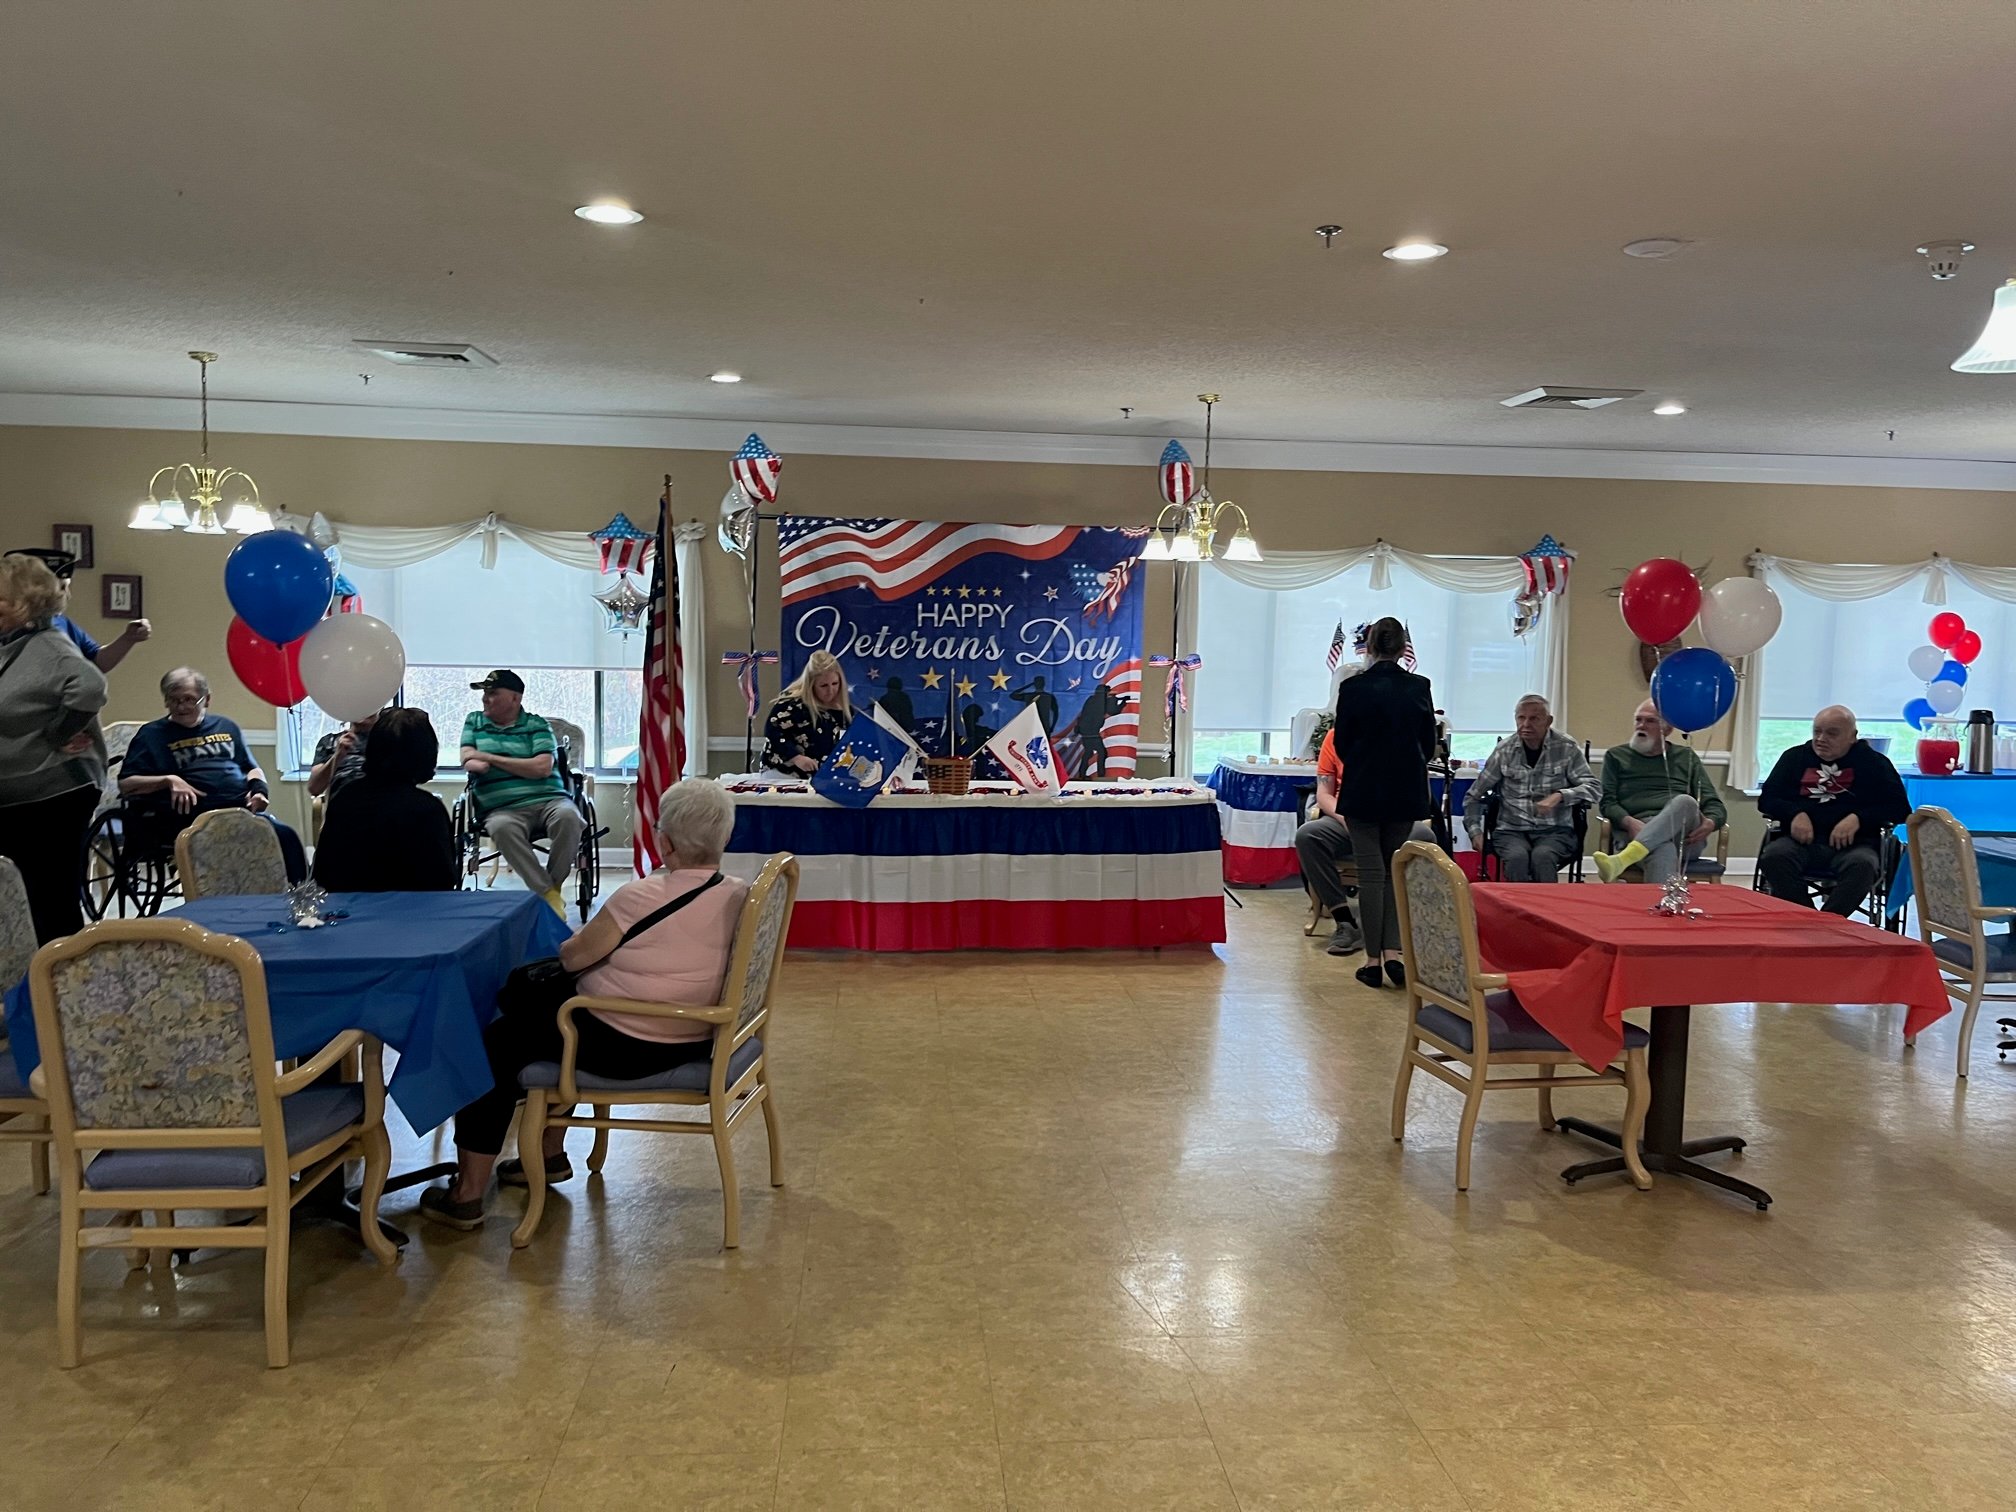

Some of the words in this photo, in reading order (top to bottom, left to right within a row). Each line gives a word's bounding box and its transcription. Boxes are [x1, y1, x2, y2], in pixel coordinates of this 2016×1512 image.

[917, 602, 1014, 628] HAPPY
[795, 605, 1005, 661] Veterans
[1015, 616, 1122, 679] Day
